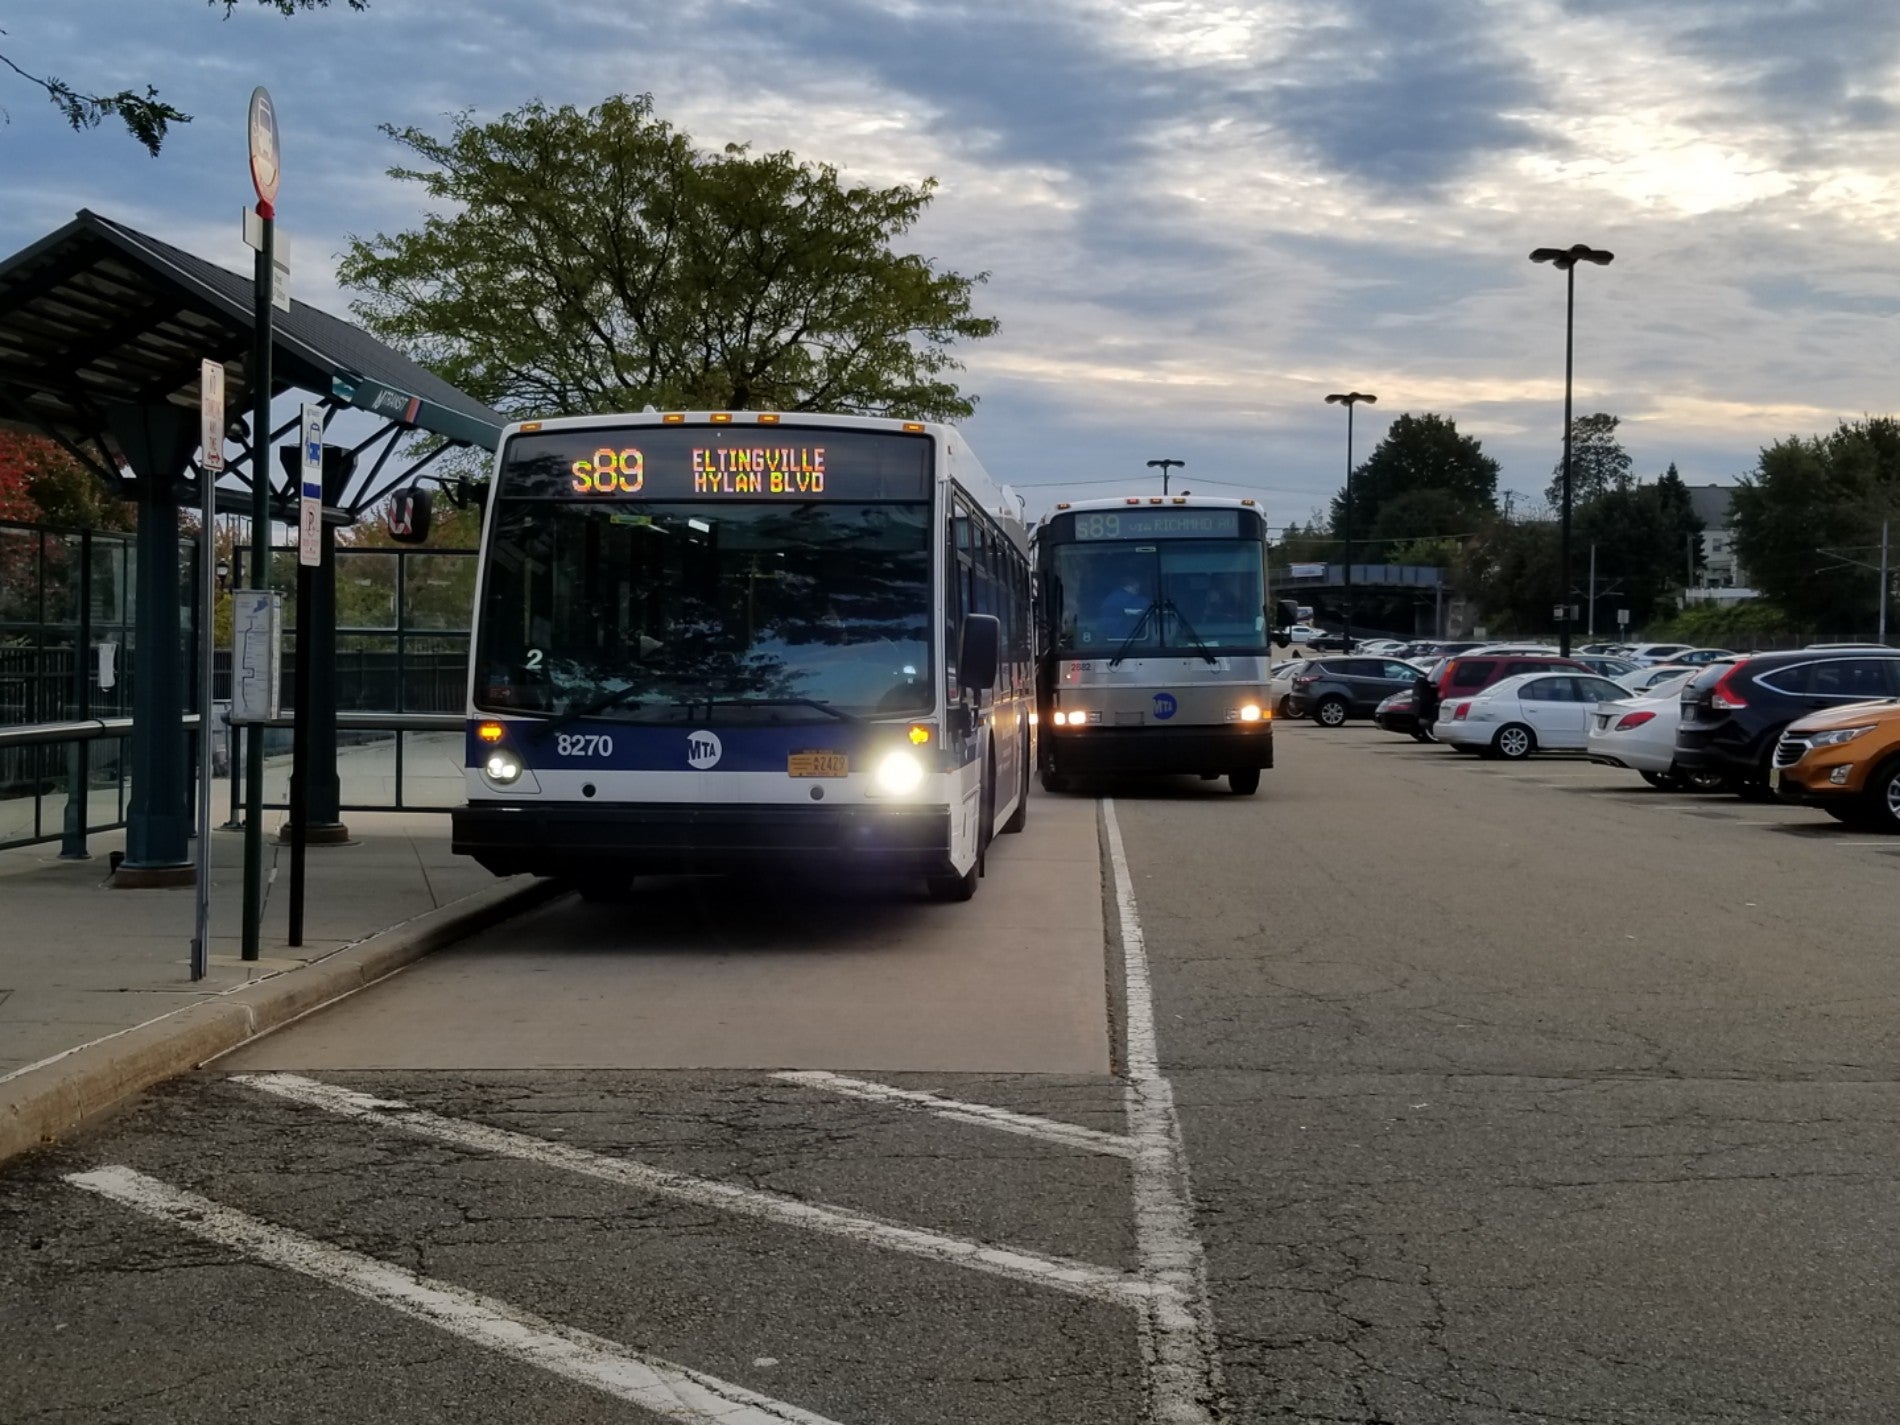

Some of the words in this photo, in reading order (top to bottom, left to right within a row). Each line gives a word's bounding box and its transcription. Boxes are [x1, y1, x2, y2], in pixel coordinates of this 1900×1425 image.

[692, 448, 825, 472] ELTINGVILLE
[694, 471, 762, 493] HYLAN
[769, 471, 824, 493] BLVD
[1083, 632, 1091, 642] 8
[526, 648, 543, 670] 2
[557, 734, 613, 757] 8270
